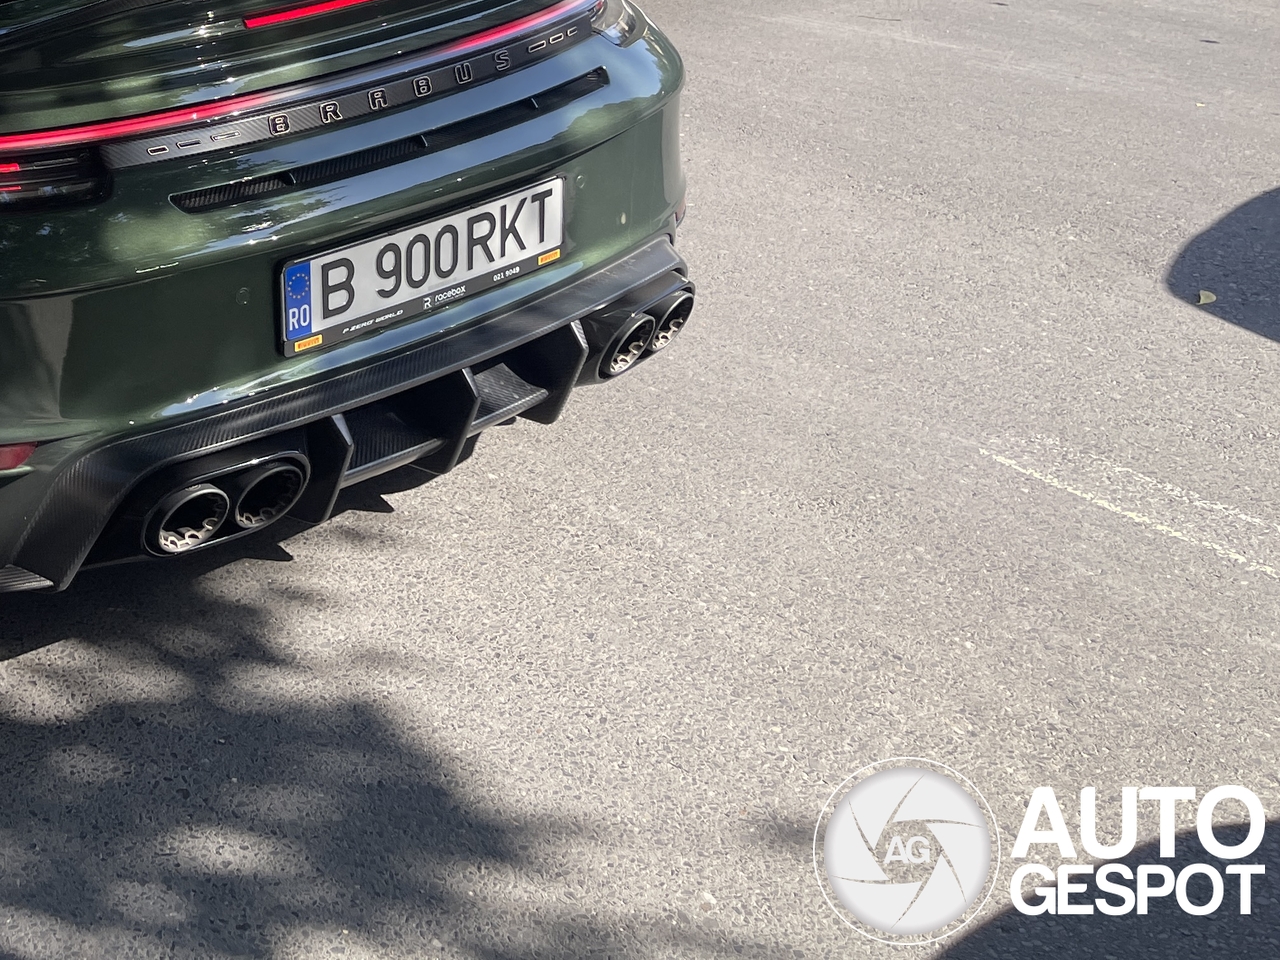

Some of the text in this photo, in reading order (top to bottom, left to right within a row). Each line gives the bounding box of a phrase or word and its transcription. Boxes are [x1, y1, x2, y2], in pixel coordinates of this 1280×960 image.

[267, 48, 512, 137] BRABUS
[288, 303, 311, 332] RO
[321, 257, 356, 320] B
